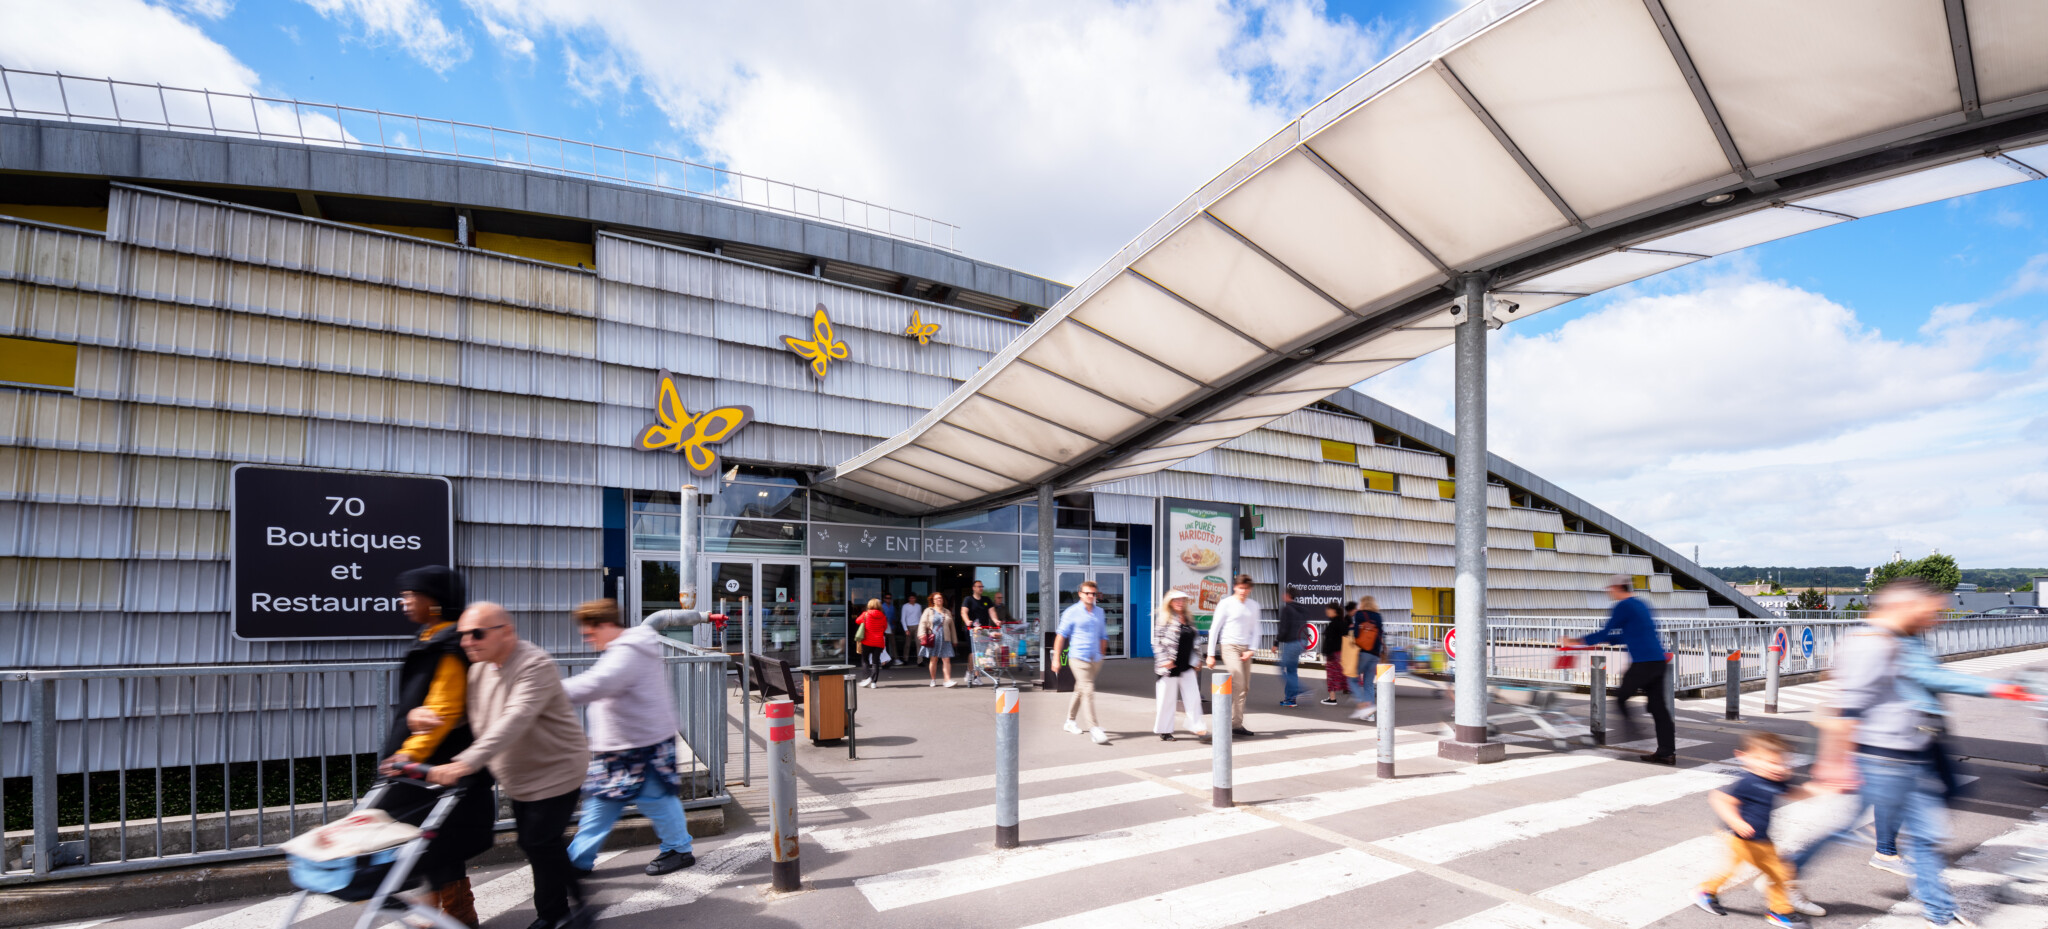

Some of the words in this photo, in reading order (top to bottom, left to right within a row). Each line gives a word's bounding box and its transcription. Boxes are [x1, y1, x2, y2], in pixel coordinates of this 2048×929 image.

[326, 496, 365, 516] 70
[1194, 520, 1216, 533] PURÉE
[267, 527, 421, 553] Boutiques
[886, 536, 954, 553] ENTRÉE
[959, 540, 968, 554] 2
[331, 563, 362, 580] et
[1287, 582, 1307, 591] Centre
[252, 593, 408, 612] Restauran
[1203, 600, 1217, 609] Blan
[1294, 594, 1342, 606] ambourcy
[1758, 600, 1803, 608] OPTICA
